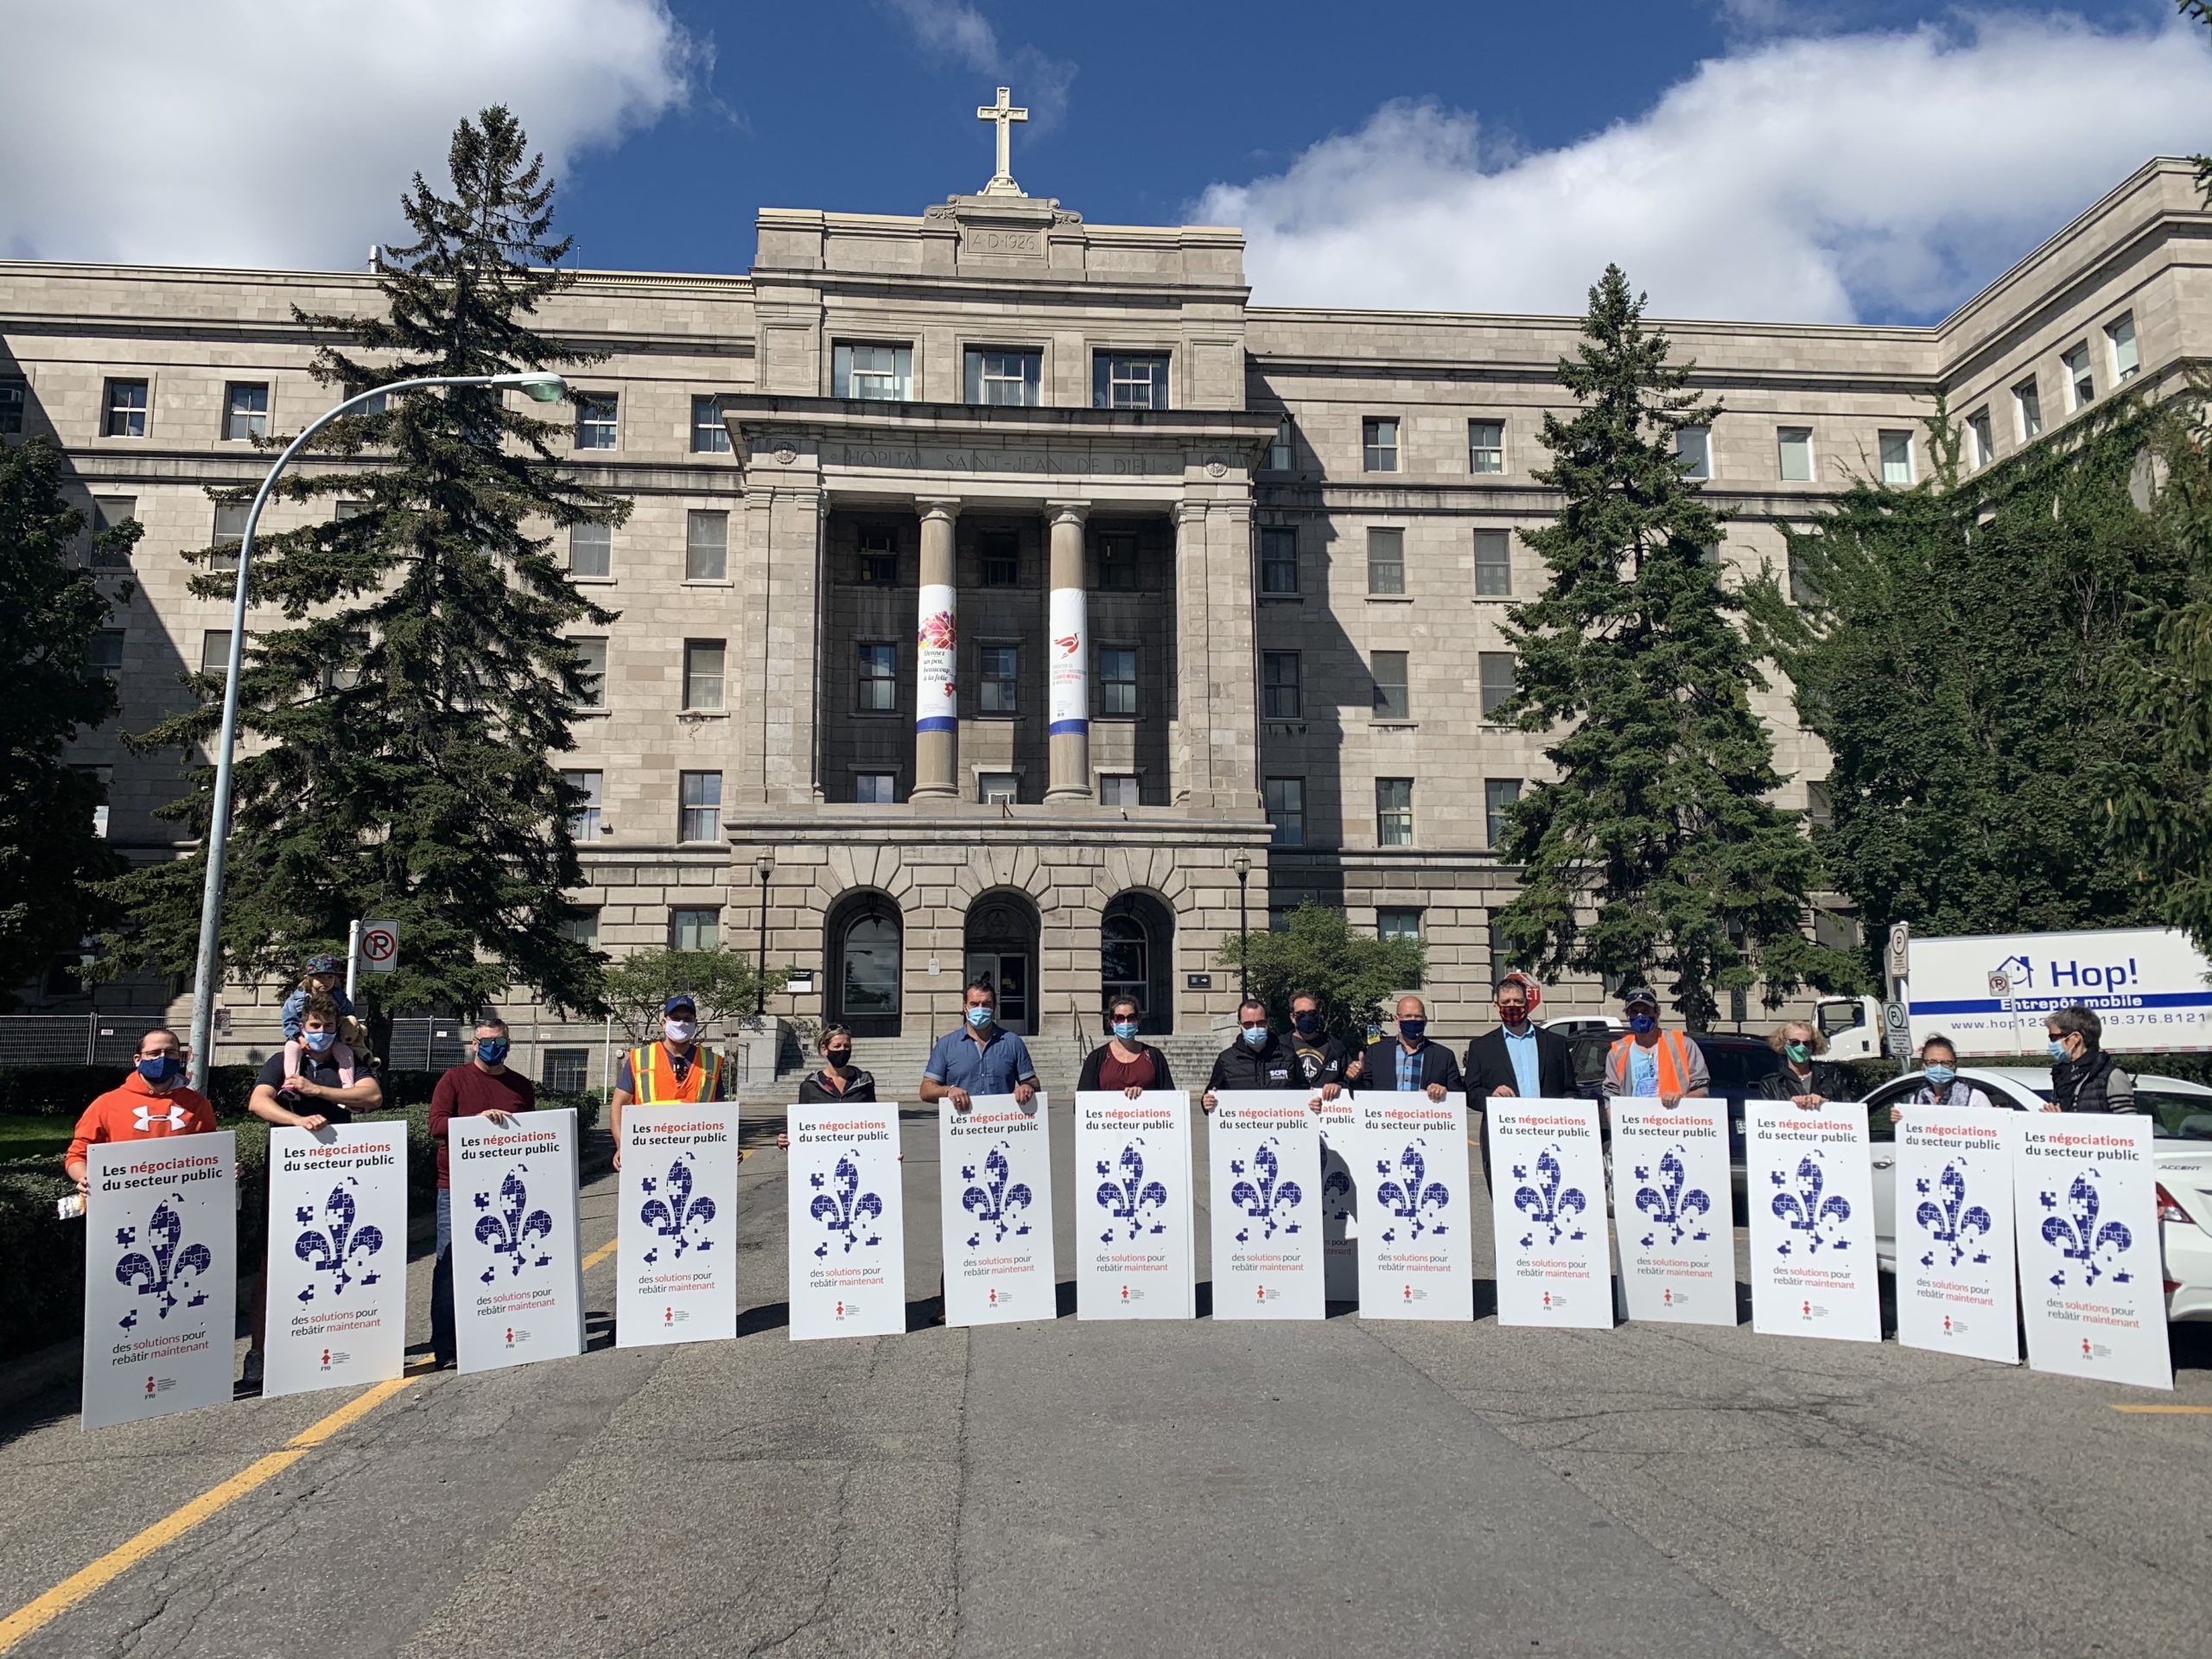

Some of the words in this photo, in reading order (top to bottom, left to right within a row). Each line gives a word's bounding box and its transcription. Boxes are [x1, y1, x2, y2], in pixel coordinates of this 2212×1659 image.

[1077, 458, 1101, 474] DE
[2050, 958, 2139, 993] Hop!
[2000, 996, 2077, 1011] Entrepôt
[2084, 995, 2143, 1007] mobile
[2101, 1013, 2205, 1025] 19.376.8121
[1085, 1109, 1103, 1119] Les
[1104, 1108, 1172, 1121] négociations
[1218, 1108, 1236, 1118] Les
[1237, 1107, 1306, 1120] négociations
[1322, 1104, 1353, 1114] ations
[1364, 1108, 1382, 1119] Les
[1383, 1108, 1453, 1121] négociations
[950, 1115, 968, 1125] Les
[969, 1110, 1036, 1125] négociations
[1325, 1115, 1356, 1125] public
[1497, 1113, 1516, 1124] Les
[1518, 1114, 1586, 1127] négociations
[1621, 1114, 1641, 1125] Les
[1642, 1115, 1714, 1127] négociations
[1757, 1117, 1777, 1128] Les
[1777, 1118, 1853, 1131] négociations
[632, 1123, 652, 1135] Les
[653, 1121, 725, 1135] négociations
[798, 1121, 817, 1132] Les
[818, 1119, 887, 1133] négociations
[950, 1125, 964, 1136] du
[965, 1125, 1006, 1135] secteur
[1007, 1121, 1039, 1135] public
[1084, 1120, 1100, 1131] du
[1101, 1121, 1141, 1131] secteur
[1142, 1119, 1175, 1132] public
[1218, 1119, 1233, 1130] du
[1234, 1120, 1274, 1130] secteur
[1275, 1119, 1309, 1131] public
[1364, 1119, 1379, 1130] du
[1380, 1121, 1421, 1130] secteur
[1422, 1121, 1457, 1133] public
[1498, 1124, 1514, 1135] du
[1515, 1127, 1555, 1136] secteur
[1557, 1127, 1591, 1139] public
[1621, 1125, 1637, 1135] du
[1637, 1127, 1681, 1137] secteur
[1681, 1127, 1718, 1139] public
[1905, 1122, 1923, 1134] Les
[1925, 1123, 1998, 1138] négociations
[461, 1136, 480, 1148] Les
[482, 1130, 556, 1147] négociations
[631, 1135, 647, 1147] du
[648, 1135, 691, 1146] secteur
[693, 1132, 728, 1146] public
[798, 1132, 813, 1143] du
[815, 1133, 855, 1143] secteur
[856, 1130, 890, 1143] public
[1757, 1129, 1773, 1140] du
[1774, 1131, 1819, 1141] secteur
[1821, 1132, 1858, 1144] public
[1904, 1135, 1920, 1146] du
[1921, 1137, 1963, 1148] secteur
[1965, 1138, 2001, 1151] public
[2024, 1130, 2046, 1143] Les
[2048, 1132, 2135, 1147] négociations
[283, 1147, 307, 1159] Les
[308, 1142, 391, 1158] négociations
[461, 1148, 477, 1160] du
[478, 1147, 523, 1160] secteur
[524, 1141, 560, 1157] public
[2024, 1144, 2042, 1156] du
[2044, 1147, 2094, 1159] secteur
[2096, 1148, 2140, 1161] public
[102, 1165, 127, 1178] Les
[130, 1155, 219, 1174] négociations
[283, 1160, 301, 1173] du
[303, 1159, 353, 1172] secteur
[355, 1154, 395, 1169] public
[101, 1179, 121, 1192] du
[124, 1174, 179, 1190] secteur
[181, 1166, 224, 1185] public
[963, 1257, 978, 1268] des
[977, 1255, 1014, 1267] solutions
[1013, 1255, 1033, 1265] pour
[1096, 1253, 1111, 1263] des
[1110, 1253, 1147, 1262] solutions
[1146, 1255, 1166, 1263] pour
[1377, 1252, 1393, 1262] des
[1392, 1253, 1429, 1262] solutions
[1428, 1255, 1449, 1264] pour
[1637, 1256, 1652, 1266] des
[1652, 1257, 1690, 1268] solutions
[1689, 1261, 1711, 1269] pour
[810, 1268, 825, 1279] des
[824, 1267, 862, 1278] solutions
[861, 1267, 882, 1277] pour
[963, 1267, 991, 1278] rebâtir
[990, 1264, 1035, 1275] maintenant
[1096, 1262, 1124, 1273] rebâtir
[1123, 1262, 1169, 1272] maintenant
[1377, 1262, 1406, 1272] rebâtir
[1406, 1263, 1452, 1273] maintenant
[1637, 1266, 1666, 1276] rebâtir
[1666, 1268, 1713, 1279] maintenant
[638, 1274, 654, 1285] des
[654, 1273, 693, 1284] solutions
[692, 1272, 714, 1282] pour
[810, 1278, 839, 1289] rebâtir
[838, 1276, 885, 1287] maintenant
[1916, 1276, 1932, 1287] des
[1931, 1280, 1970, 1294] solutions
[1969, 1286, 1992, 1295] pour
[638, 1284, 668, 1295] rebâtir
[667, 1281, 715, 1293] maintenant
[476, 1295, 493, 1306] des
[493, 1291, 532, 1304] solutions
[531, 1287, 553, 1300] pour
[1916, 1287, 1946, 1300] rebâtir
[1945, 1293, 1994, 1307] maintenant
[476, 1304, 507, 1317] rebâtir
[506, 1297, 556, 1313] maintenant
[2045, 1297, 2064, 1309] des
[2064, 1300, 2111, 1314] solutions
[2110, 1306, 2136, 1317] pour
[290, 1315, 309, 1326] des
[310, 1311, 355, 1324] solutions
[354, 1307, 379, 1320] pour
[2047, 1309, 2082, 1322] rebâtir
[2082, 1314, 2141, 1330] maintenant
[290, 1324, 326, 1338] rebâtir
[326, 1318, 382, 1333] maintenant
[111, 1343, 132, 1355] des
[133, 1334, 181, 1351] solutions
[181, 1330, 207, 1344] pour
[111, 1351, 149, 1367] rebâtir
[149, 1340, 210, 1360] maintenant
